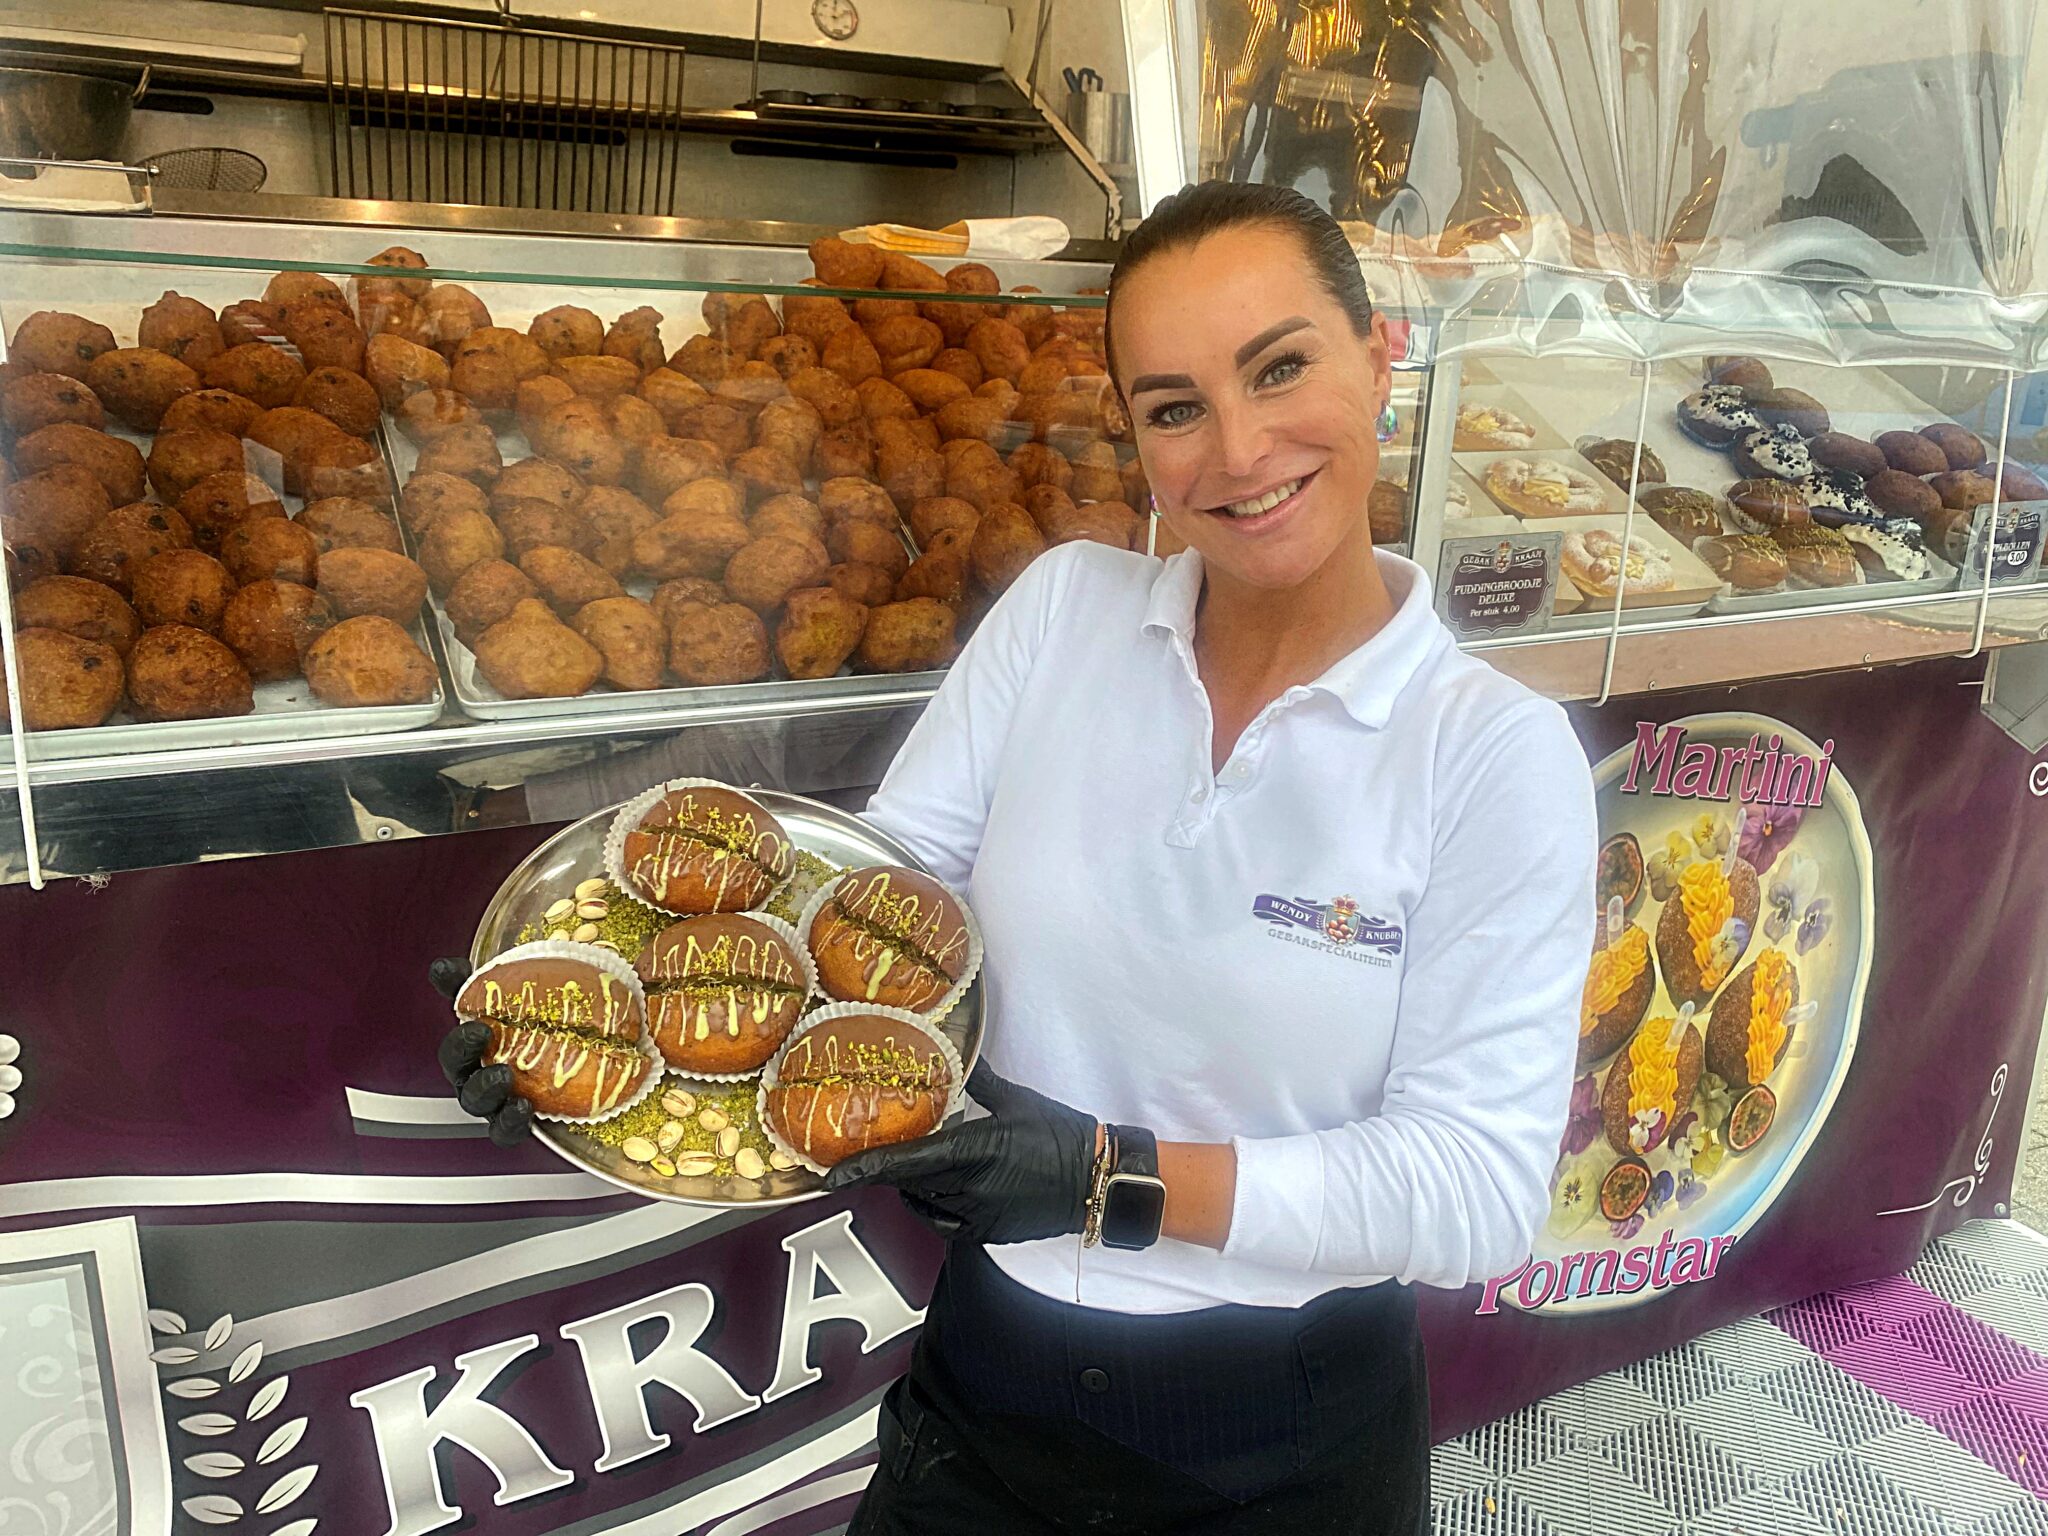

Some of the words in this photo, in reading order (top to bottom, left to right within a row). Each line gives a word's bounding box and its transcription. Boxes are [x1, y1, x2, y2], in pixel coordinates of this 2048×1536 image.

[1462, 556, 1491, 565] GEBAK
[1515, 550, 1543, 563] KRAAM
[2009, 551, 2026, 563] 3,00
[1453, 578, 1542, 596] PUDDINGBROODJE
[1478, 593, 1516, 605] DELUXE
[1470, 609, 1482, 618] Per
[1483, 606, 1500, 616] stuk
[1502, 604, 1520, 614] 4,00
[1621, 721, 1835, 807] Martini
[1271, 900, 1313, 923] WENDY
[1267, 928, 1392, 969] GEBAKSPECIALITEITEN
[1475, 1228, 1736, 1316] Pornstar
